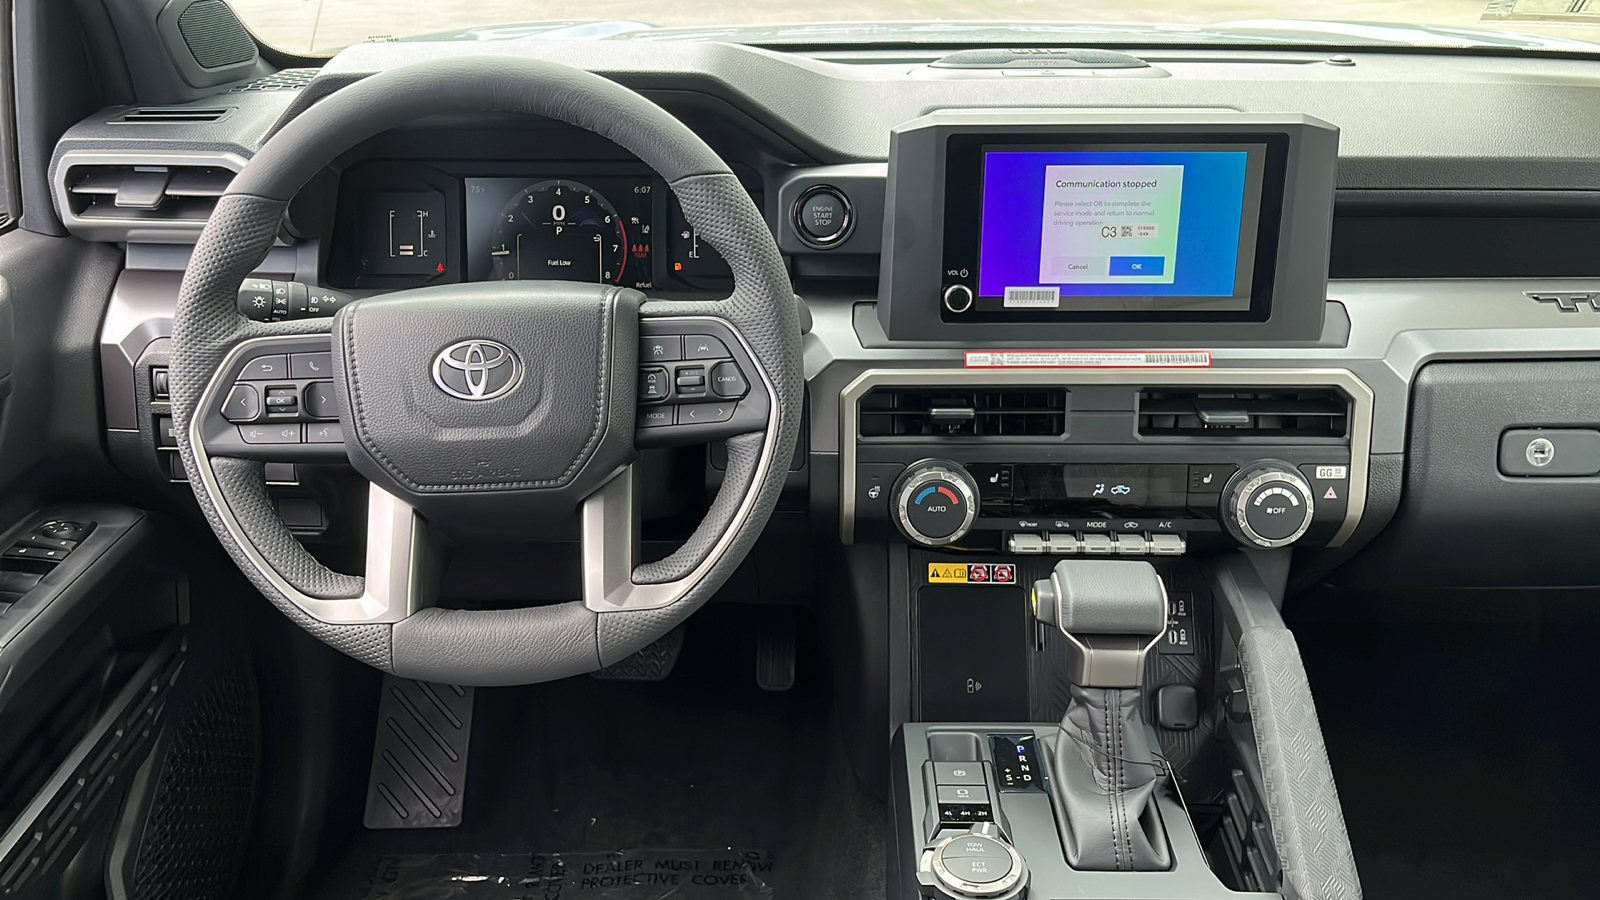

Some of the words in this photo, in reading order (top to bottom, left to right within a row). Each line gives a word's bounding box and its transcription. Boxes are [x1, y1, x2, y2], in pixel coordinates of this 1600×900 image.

[1055, 180, 1120, 188] Communication
[1122, 180, 1157, 189] stopped
[634, 186, 651, 194] 6:07
[584, 196, 590, 204] 5
[552, 205, 565, 220] 0
[556, 227, 562, 235] P
[1101, 226, 1117, 238] C3
[605, 271, 610, 279] 8
[1320, 468, 1332, 477] GG
[1017, 745, 1025, 753] P
[583, 860, 643, 875] DEALER
[655, 859, 701, 871] MUST
[581, 872, 680, 889] PROTECTIVE
